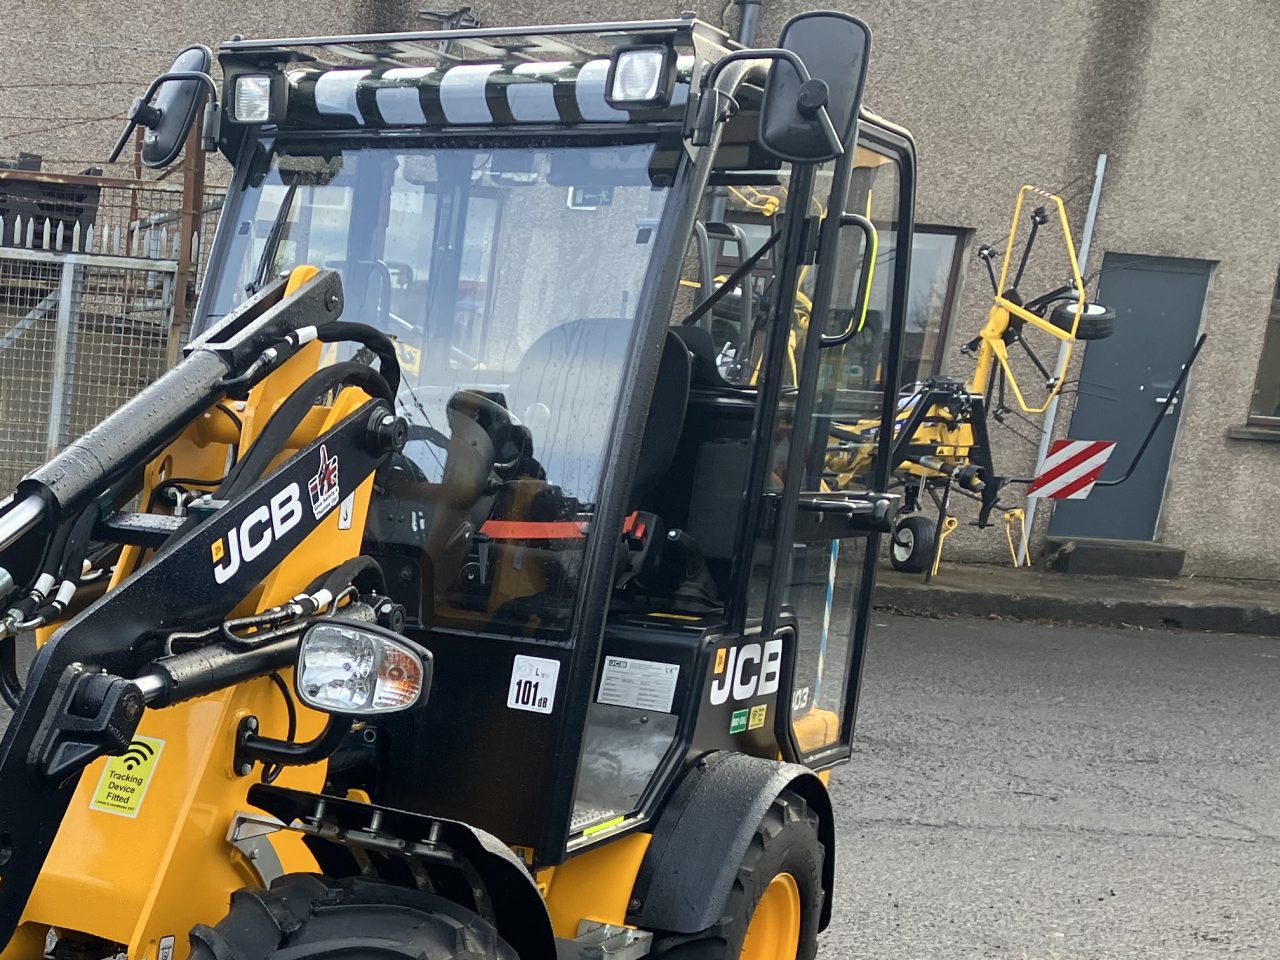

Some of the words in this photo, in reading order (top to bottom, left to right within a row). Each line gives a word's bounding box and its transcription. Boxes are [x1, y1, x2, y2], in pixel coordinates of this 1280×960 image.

[214, 482, 302, 584] JCB
[710, 639, 782, 705] JCB
[515, 679, 540, 706] 101
[108, 781, 135, 793] Device
[109, 770, 144, 786] Tracking
[106, 792, 130, 804] Fitted
